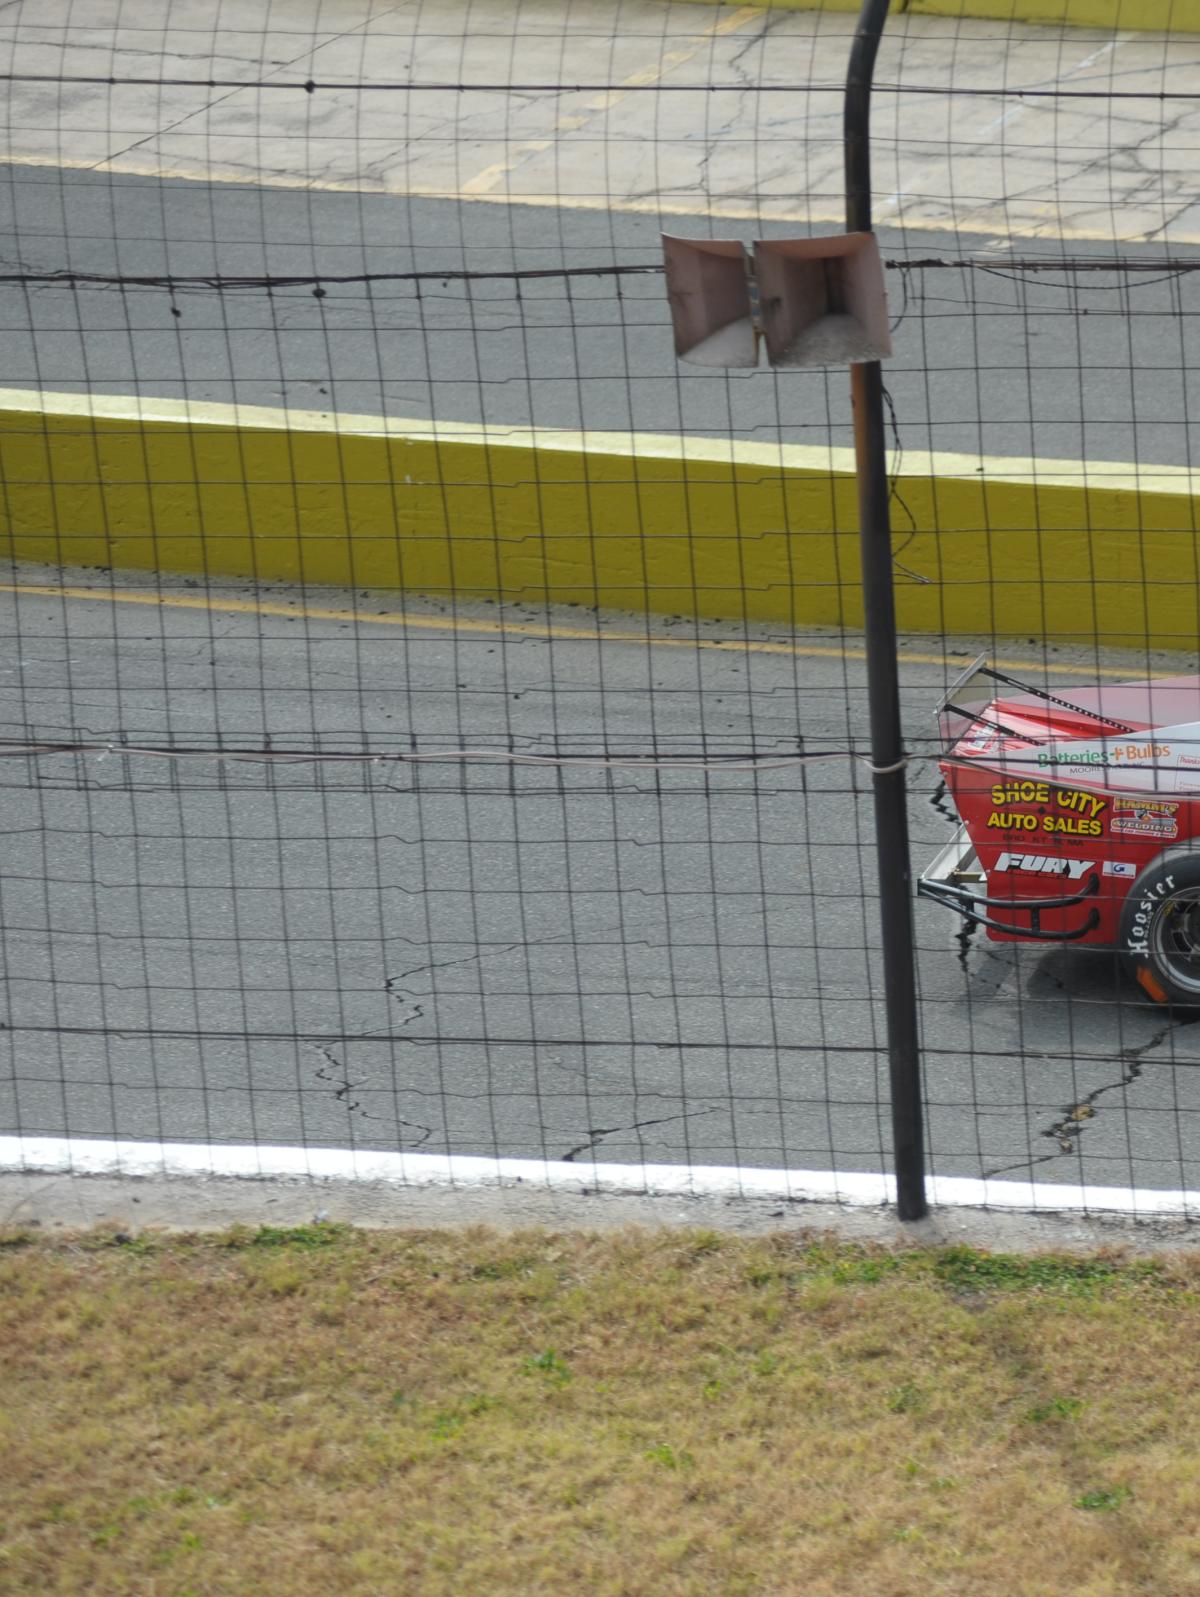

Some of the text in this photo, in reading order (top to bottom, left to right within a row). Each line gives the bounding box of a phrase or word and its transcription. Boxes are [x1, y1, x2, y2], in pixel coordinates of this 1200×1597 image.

[1038, 750, 1109, 768] Batteries
[1126, 744, 1171, 760] Bulbs
[992, 782, 1106, 818] SHOE CITY
[987, 812, 1038, 831] AUTO
[1042, 816, 1103, 836] SALES
[994, 852, 1096, 879] FURY
[1128, 875, 1175, 958] Hoosier
